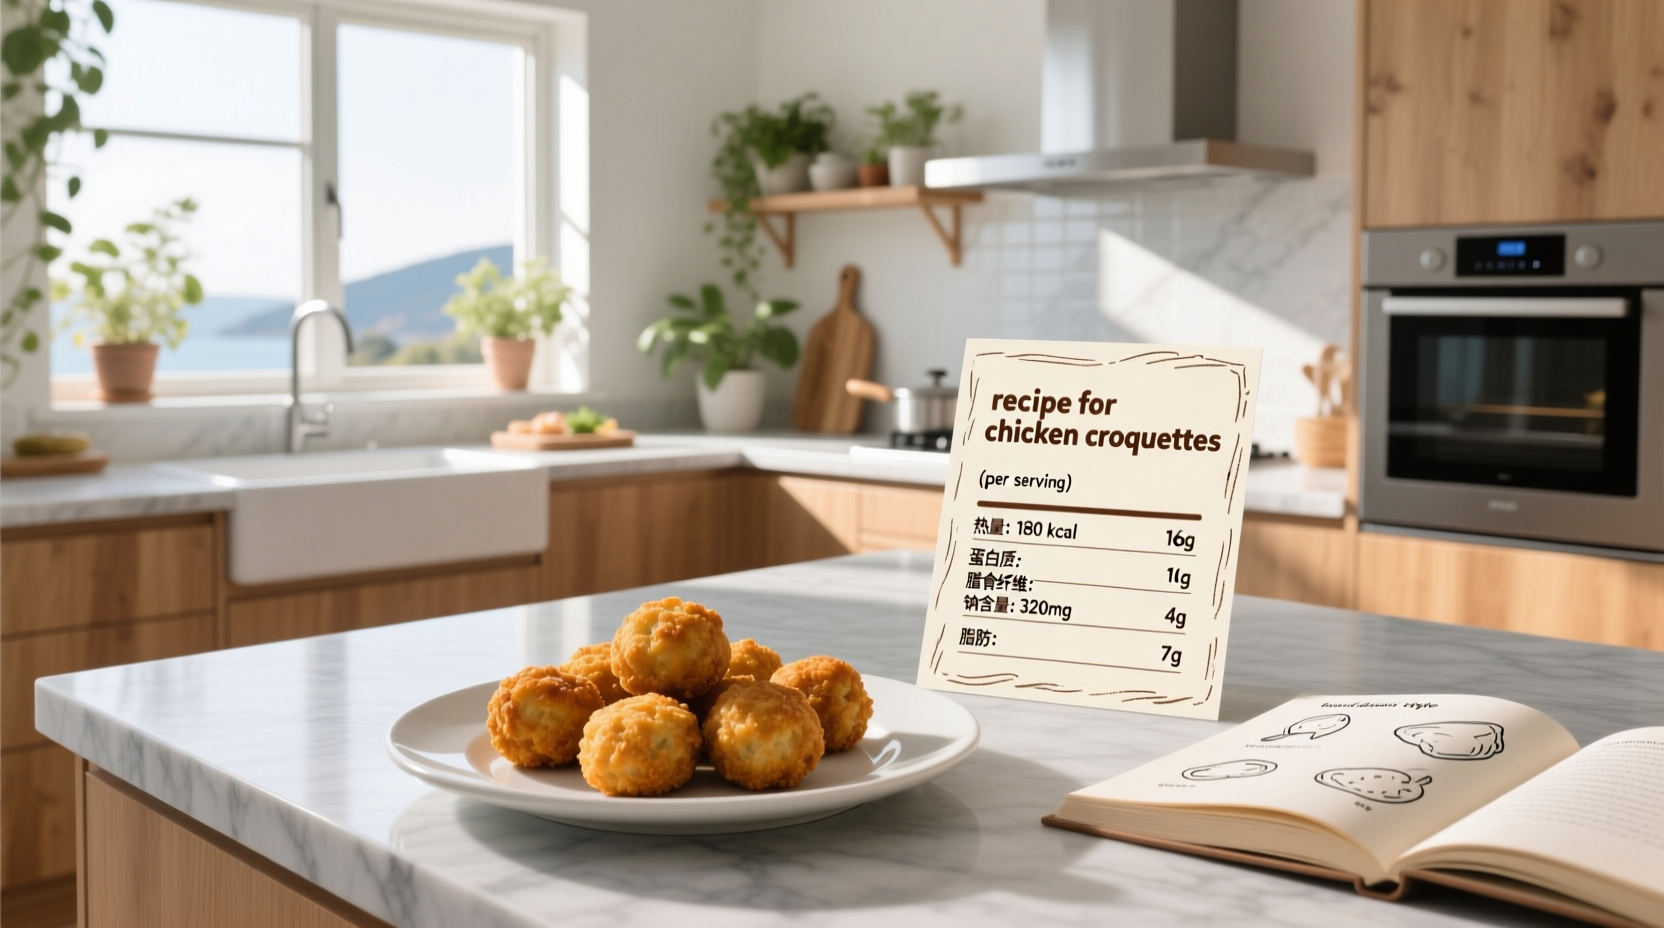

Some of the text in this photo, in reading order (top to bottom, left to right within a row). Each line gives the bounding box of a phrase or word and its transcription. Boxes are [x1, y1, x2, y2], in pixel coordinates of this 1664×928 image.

[991, 387, 1118, 421] recipe for
[984, 418, 1222, 457] chicken croquettes
[978, 469, 1073, 494] (per serving)
[1016, 520, 1043, 537] 180
[1046, 521, 1078, 540] kcal
[1165, 529, 1196, 552] 16g
[1019, 598, 1072, 622] 320mg
[1164, 606, 1187, 630] 4g
[1160, 645, 1183, 668] 7g
